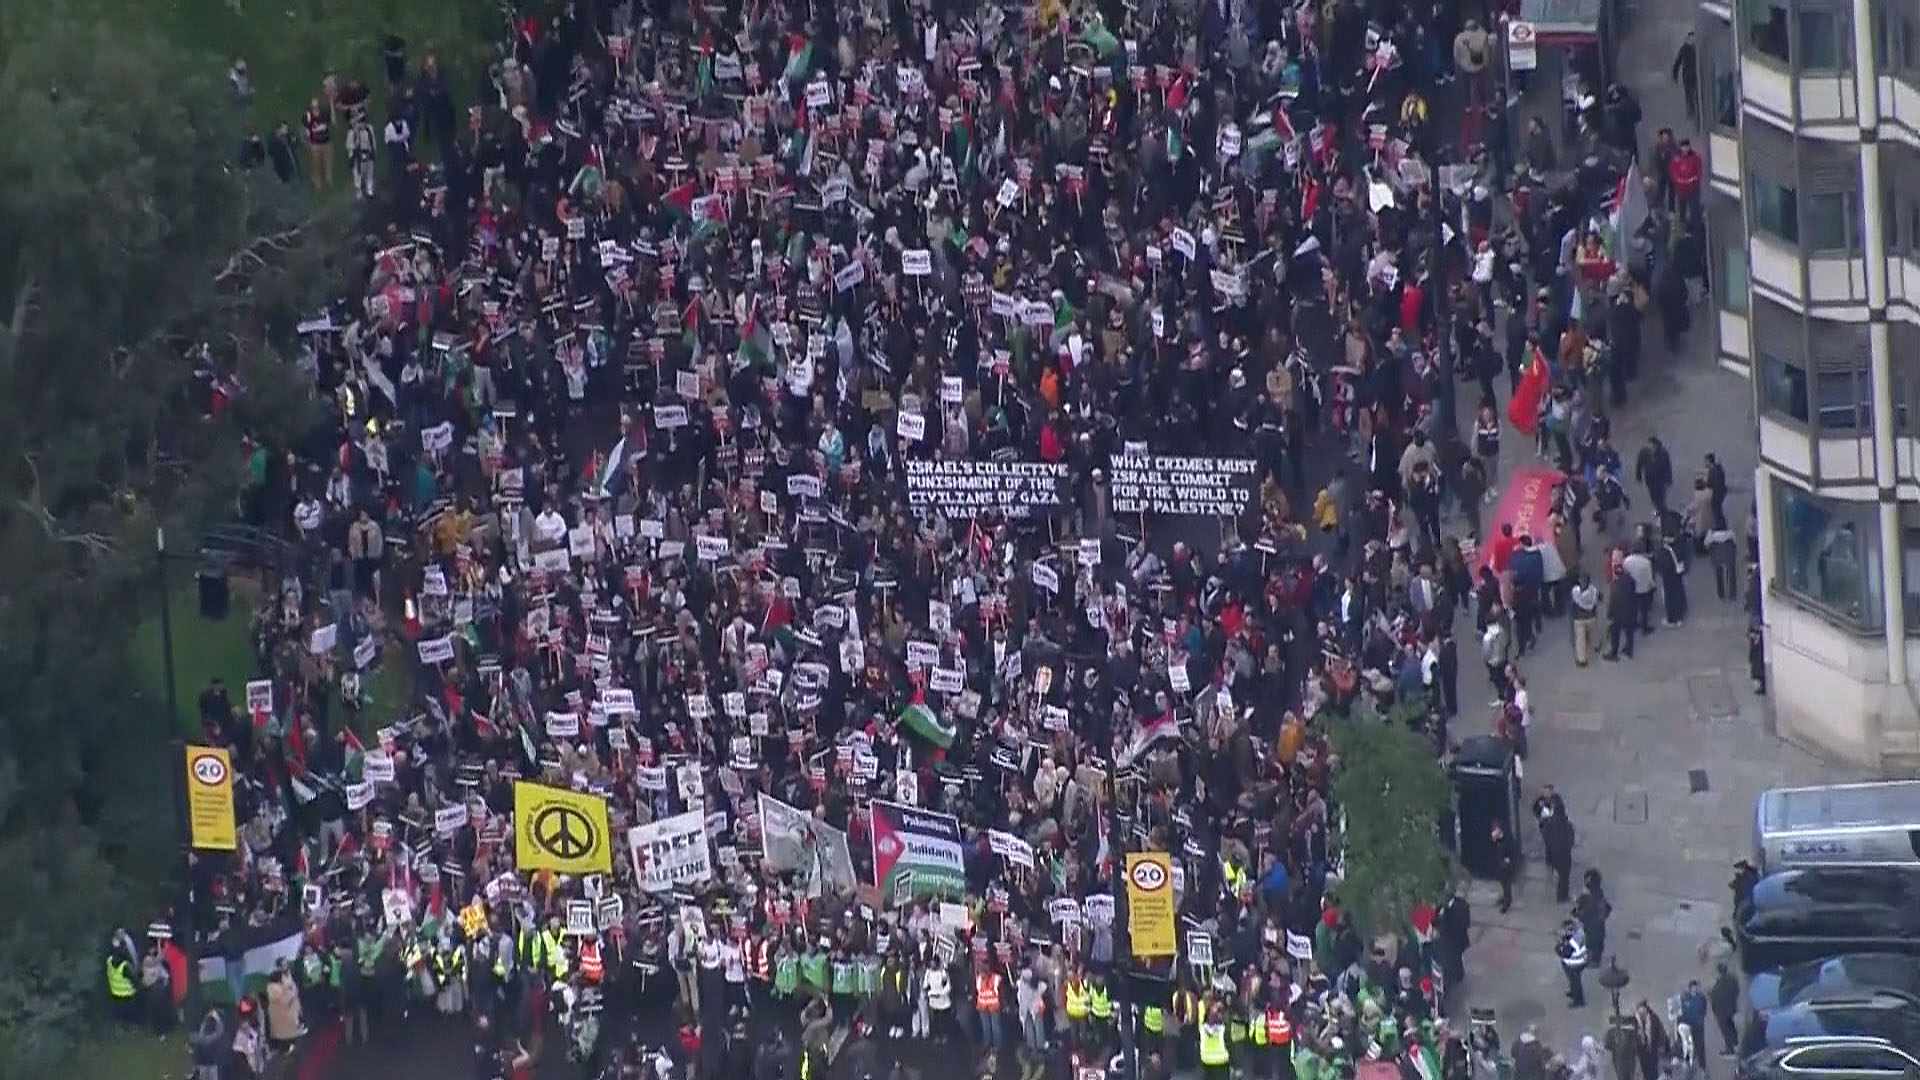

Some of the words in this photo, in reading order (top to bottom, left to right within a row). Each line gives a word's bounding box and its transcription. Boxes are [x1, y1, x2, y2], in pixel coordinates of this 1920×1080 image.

[906, 460, 973, 475] ISRAEL'S
[975, 462, 1069, 477] COLLECTIVE
[1109, 455, 1150, 469] WHAT
[1155, 457, 1213, 471] CRIMES
[1217, 459, 1258, 474] MUST
[907, 476, 1001, 489] PUNISHMENT
[1005, 477, 1022, 489] OF
[1029, 478, 1056, 490] THE
[1110, 470, 1167, 484] ISRAEL
[1170, 472, 1231, 486] COMMIT
[908, 491, 993, 504] CIVILIANS
[998, 491, 1016, 504] OF
[1020, 492, 1060, 504] GAZA
[1112, 484, 1139, 497] FOR
[1144, 486, 1172, 499] THE
[1175, 486, 1227, 501] WORLD
[1231, 488, 1249, 501] TO
[945, 505, 977, 519] WAR
[1112, 499, 1149, 512] HELP
[1153, 501, 1245, 516] PALESTINE?
[196, 763, 222, 777] 20
[908, 842, 958, 864] Solidarity
[1135, 868, 1162, 882] 20
